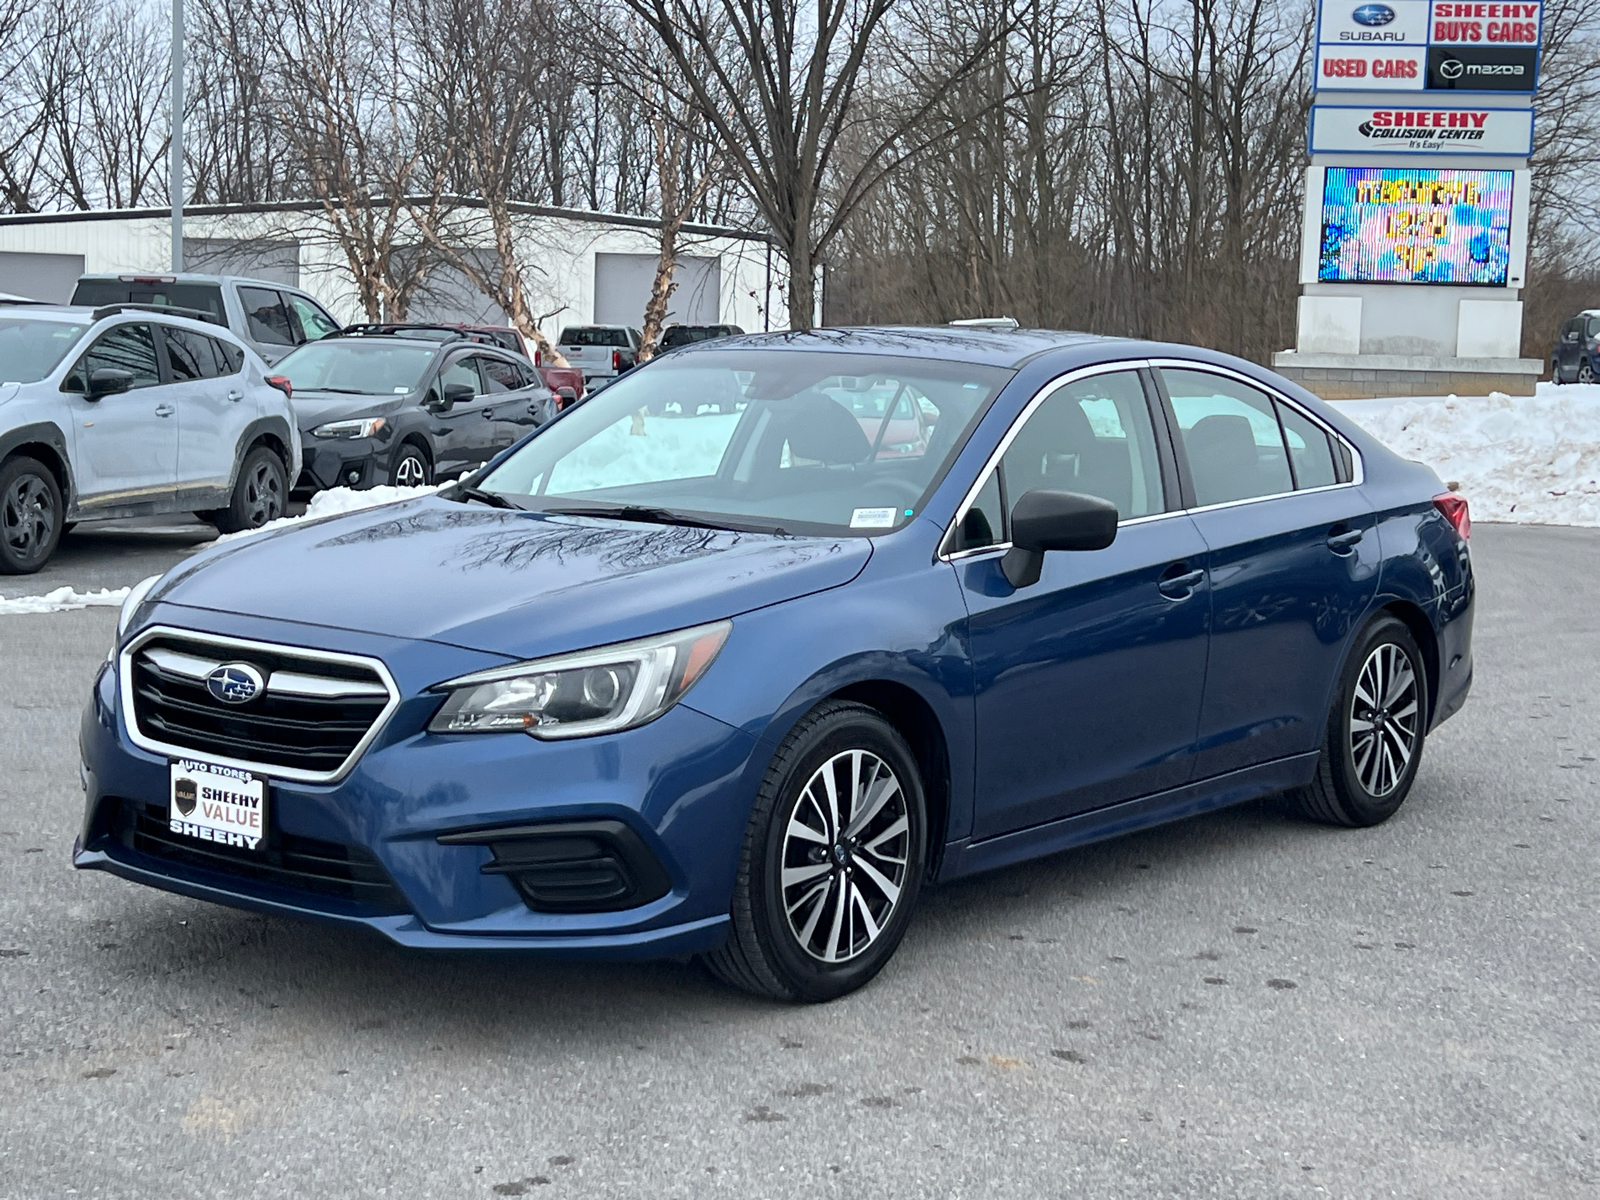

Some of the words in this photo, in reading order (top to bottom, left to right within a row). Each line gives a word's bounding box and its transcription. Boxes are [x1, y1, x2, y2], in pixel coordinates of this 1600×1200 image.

[1435, 4, 1538, 19] SHEEHY
[1339, 31, 1405, 41] SUBARU
[1434, 21, 1482, 41] BUYS
[1487, 23, 1537, 43] CARS
[1323, 58, 1367, 78] USED
[1372, 59, 1418, 79] CARS
[1466, 64, 1525, 75] mazda
[1372, 111, 1489, 128] SHEEHY
[1371, 128, 1436, 139] COLLISION
[1437, 129, 1485, 140] CENTER
[1408, 140, 1421, 149] It's
[1422, 140, 1444, 150] Easy!
[179, 760, 207, 772] AUTO
[210, 765, 252, 782] STORES
[202, 787, 259, 808] SHEEHY
[202, 801, 259, 828] VALUE
[170, 819, 260, 850] SHEEHY
